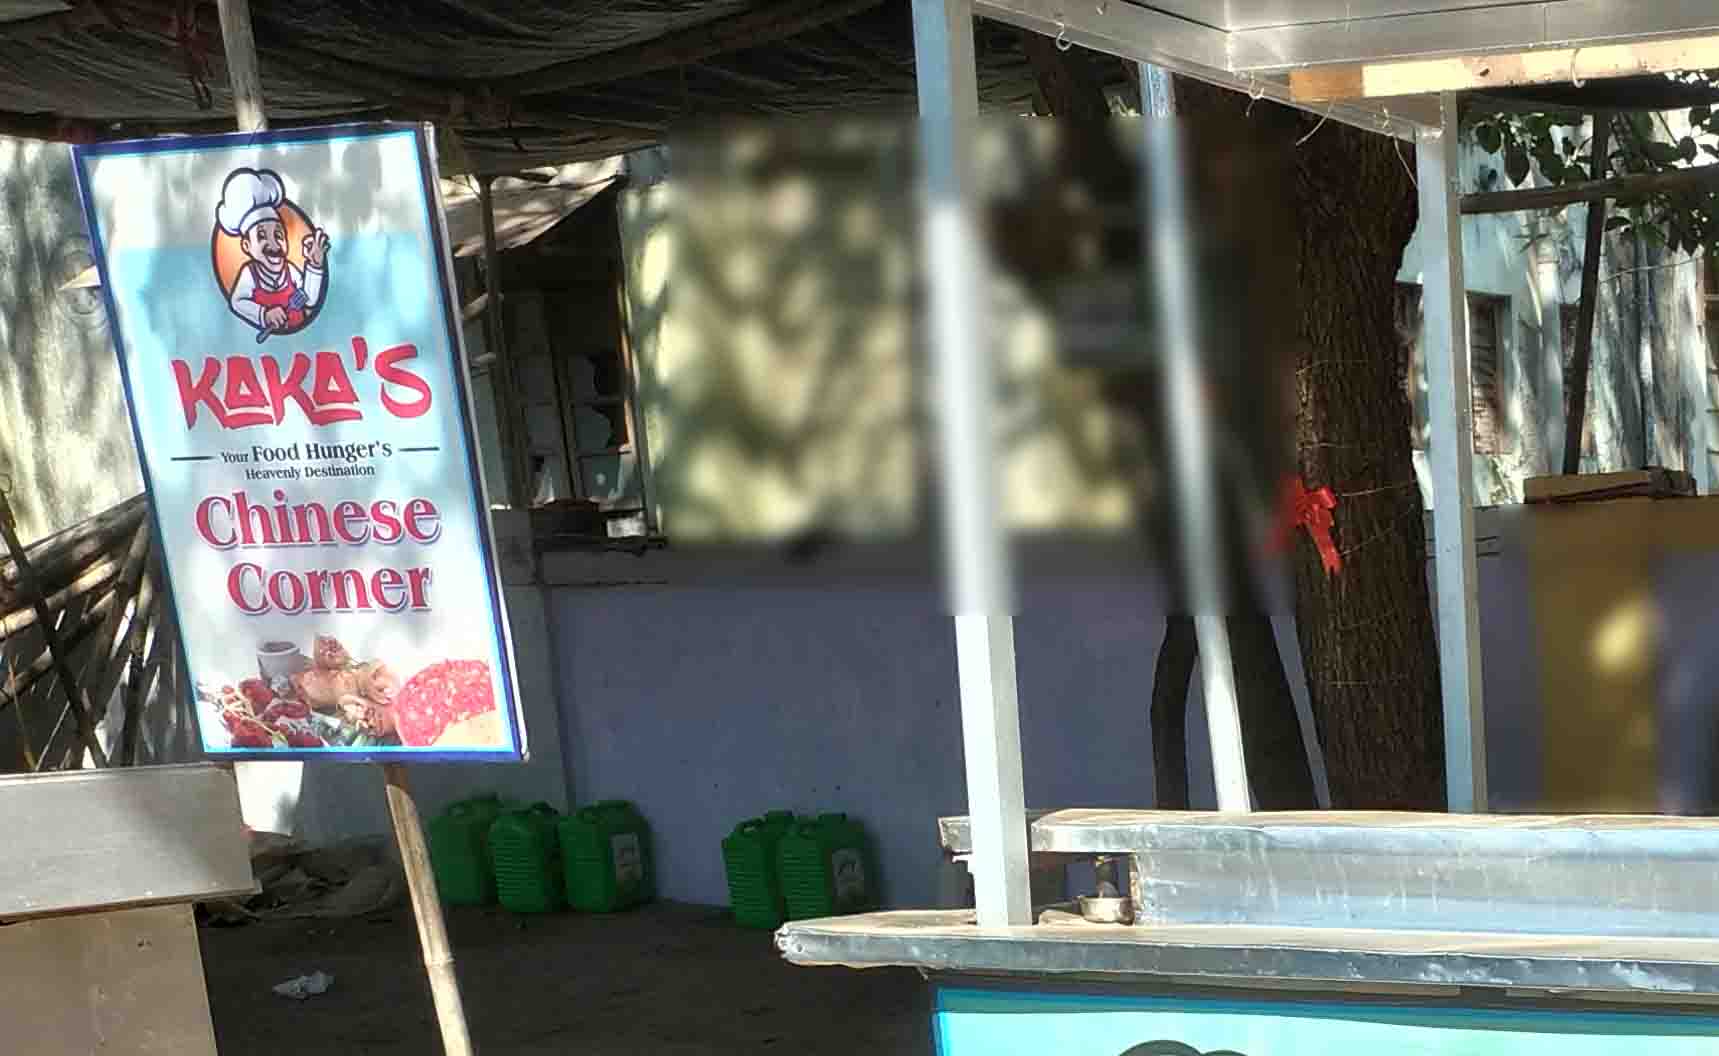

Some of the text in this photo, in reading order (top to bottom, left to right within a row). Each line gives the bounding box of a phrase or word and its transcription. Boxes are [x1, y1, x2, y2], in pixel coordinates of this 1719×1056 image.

[171, 336, 432, 431] KAKA'S
[221, 440, 393, 464] Your Food Hunger's
[246, 464, 375, 481] Heavenly Destination
[195, 489, 441, 549] Chinese
[227, 562, 432, 615] Corner
